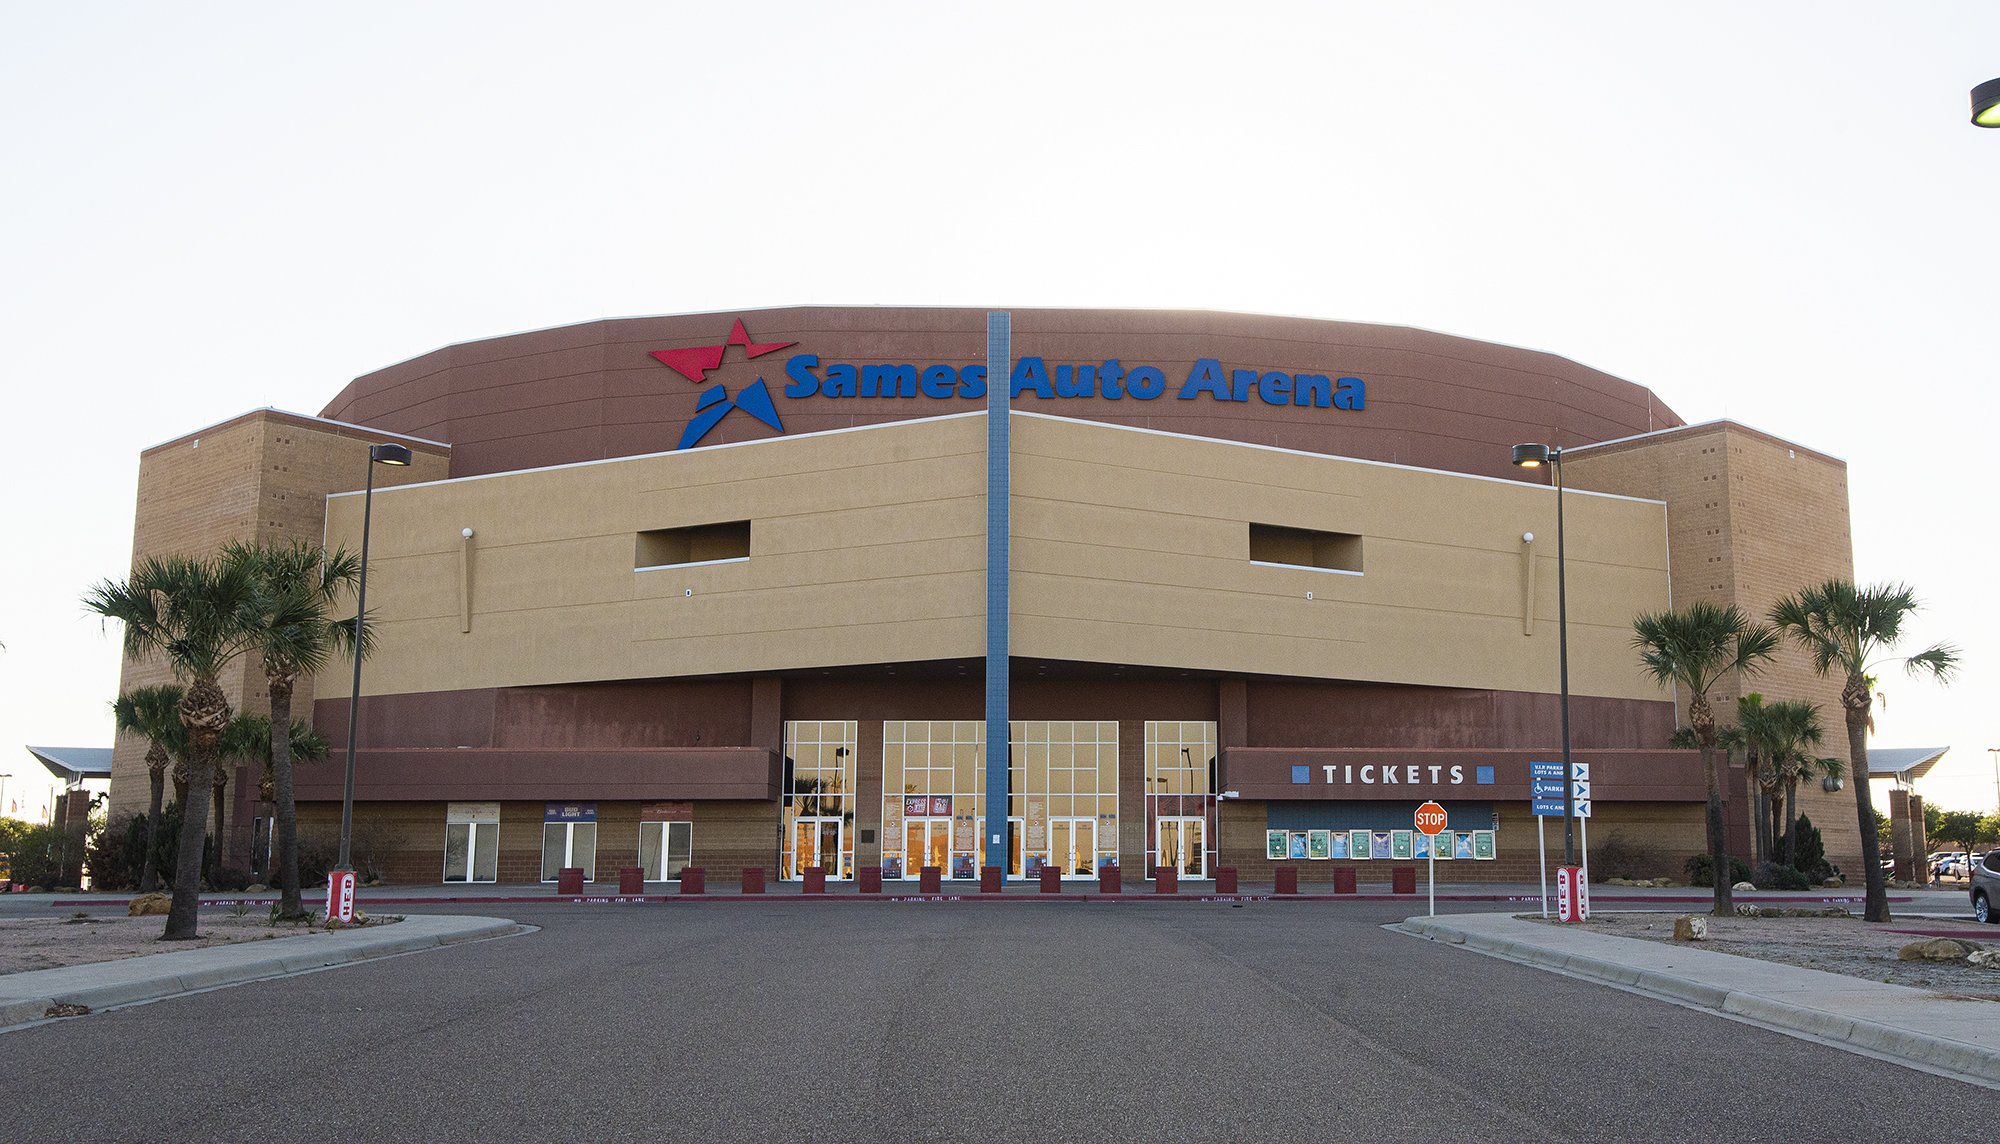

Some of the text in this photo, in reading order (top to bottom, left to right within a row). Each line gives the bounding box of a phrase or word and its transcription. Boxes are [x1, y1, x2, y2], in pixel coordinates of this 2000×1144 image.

[785, 354, 1365, 410] Sames Auto Arena
[1322, 765, 1464, 784] TICKETS
[1417, 812, 1444, 825] STOP
